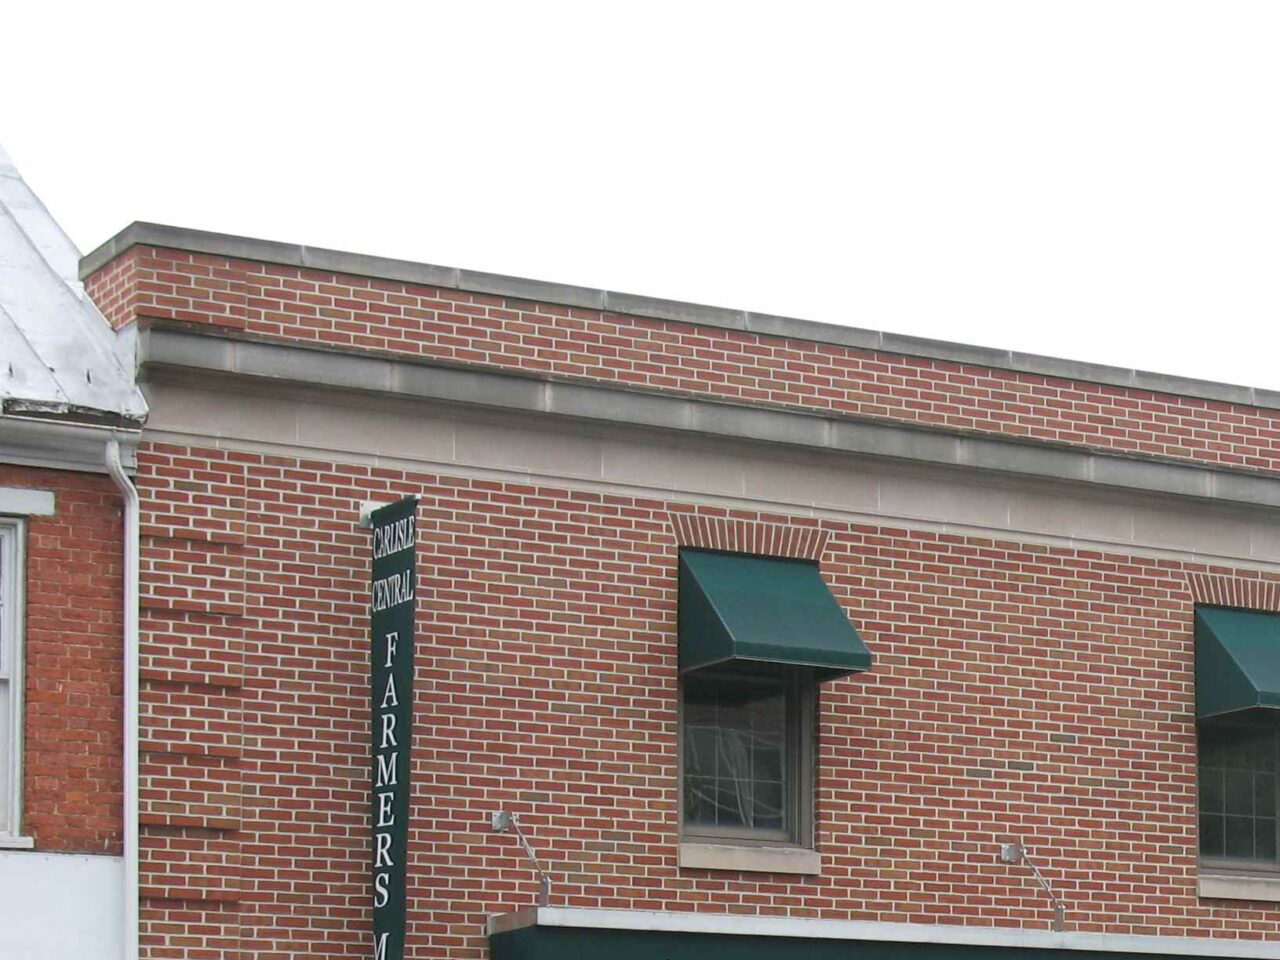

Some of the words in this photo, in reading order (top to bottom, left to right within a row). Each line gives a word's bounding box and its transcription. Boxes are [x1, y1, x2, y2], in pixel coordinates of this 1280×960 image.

[373, 515, 415, 559] CARLISLE
[371, 569, 414, 612] CENTRAL
[373, 632, 399, 909] FARMERS
